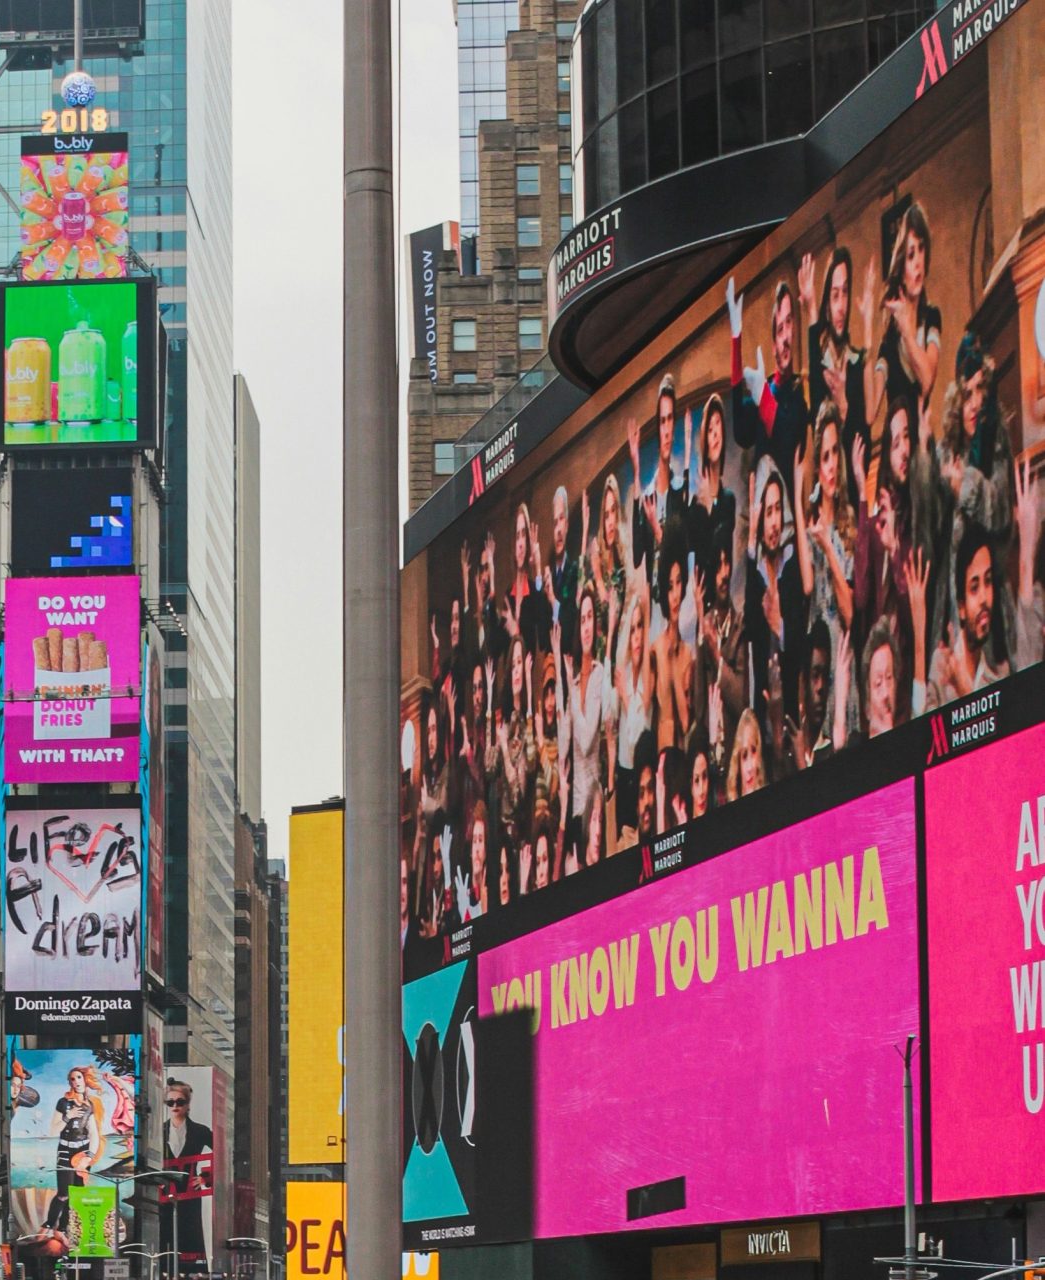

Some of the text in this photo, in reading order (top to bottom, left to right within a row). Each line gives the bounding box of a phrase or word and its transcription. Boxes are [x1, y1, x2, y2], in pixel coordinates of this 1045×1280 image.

[41, 108, 107, 134] 2018
[54, 137, 94, 152] bubly
[555, 207, 622, 273] MARRIOTT
[423, 250, 435, 297] NOW
[556, 245, 612, 303] MARQUIS
[425, 305, 437, 344] OUT
[485, 421, 518, 464] MARRIOTT
[485, 449, 515, 486] MARQUIS
[38, 595, 106, 610] DO YOU
[46, 611, 98, 626] WANT
[41, 699, 96, 712] DONUT
[951, 691, 1002, 726] MARRIOTT
[41, 713, 83, 726] FRIES
[952, 716, 996, 748] MARQUIS
[19, 747, 124, 764] WITH THAT?
[654, 830, 685, 854] MARRIOTT
[654, 850, 682, 873] MARQUIS
[452, 925, 473, 943] MARRIOTT
[491, 846, 889, 1035] YOU KNOW YOU WANNA
[452, 941, 471, 958] MARQUIS
[15, 996, 132, 1013] Domingo Zapata
[41, 1013, 106, 1022] @domingozapata
[88, 1209, 97, 1255] PISTACHIOS
[748, 1229, 791, 1256] INVICTA
